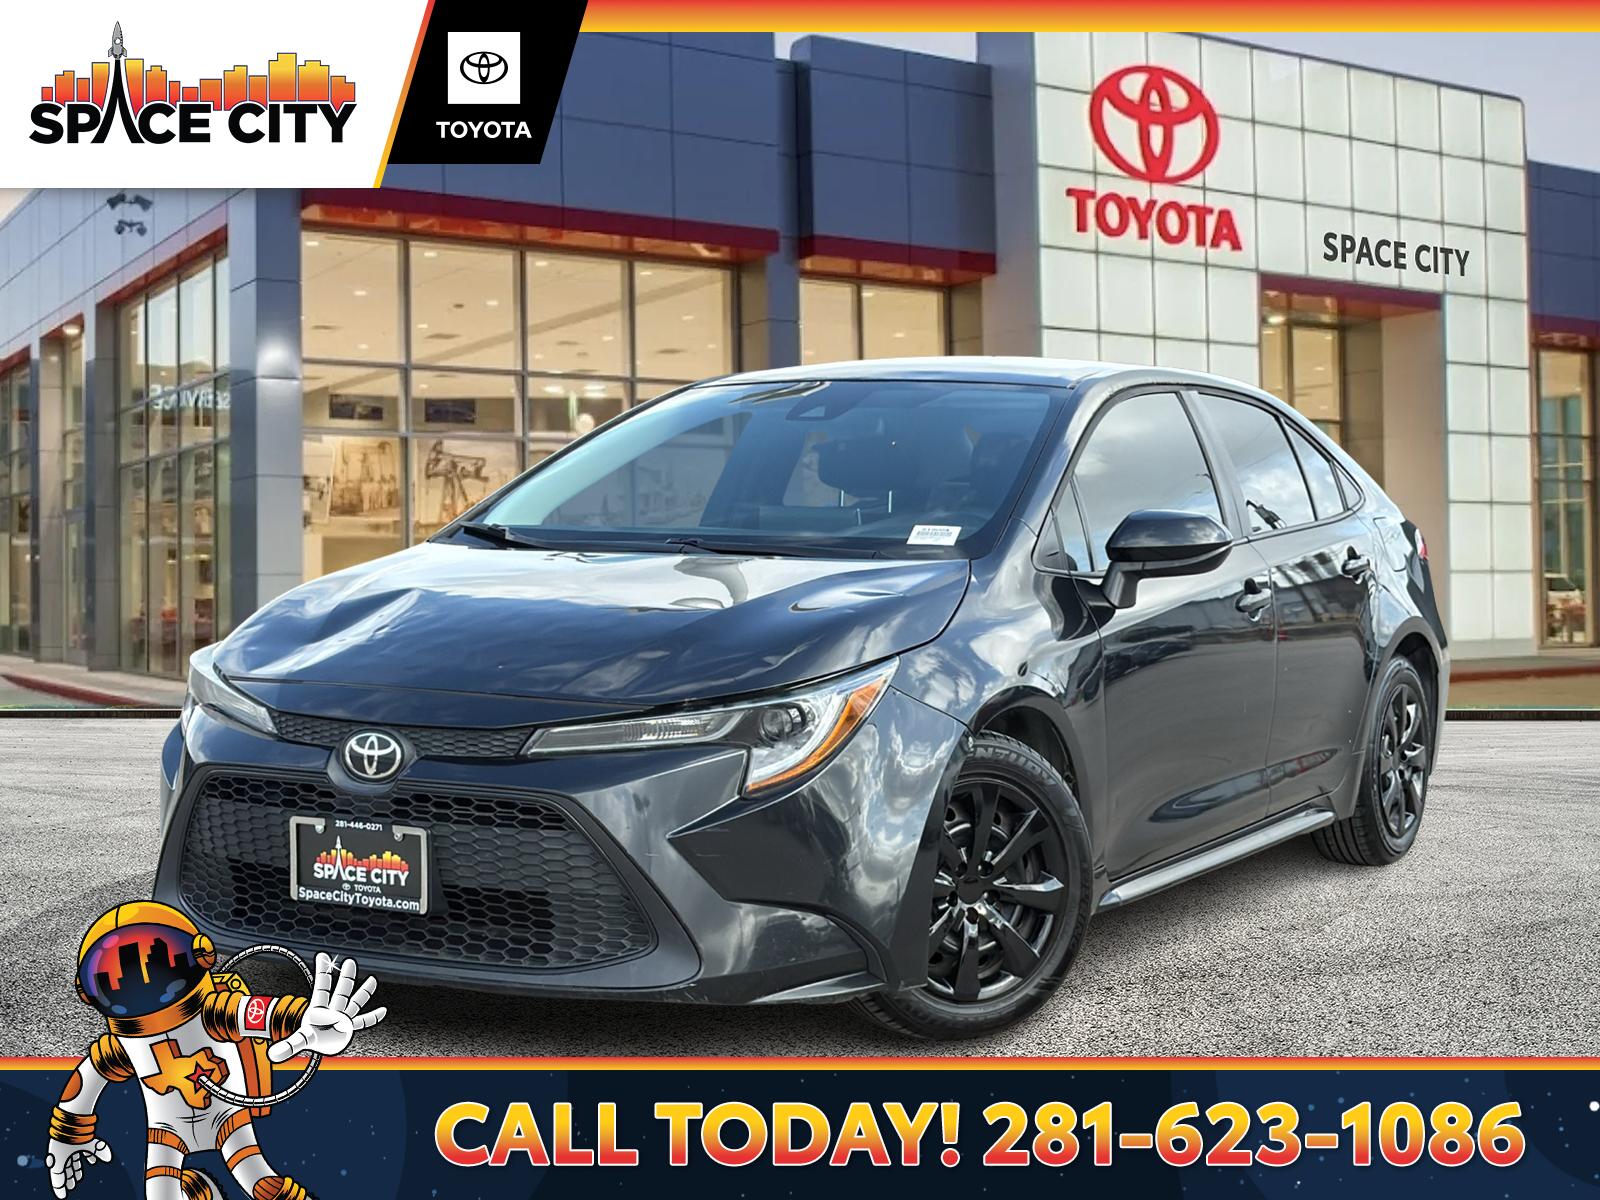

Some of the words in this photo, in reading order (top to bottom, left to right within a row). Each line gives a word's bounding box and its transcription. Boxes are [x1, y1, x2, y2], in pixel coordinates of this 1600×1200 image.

[1066, 187, 1242, 251] TOYOTA
[1323, 232, 1407, 270] SPACE
[1414, 244, 1470, 277] CITY
[313, 857, 367, 882] SPACE
[370, 868, 409, 886] CITY
[298, 886, 420, 911] SpaceCityToyota.com
[354, 884, 381, 893] TOYOTA
